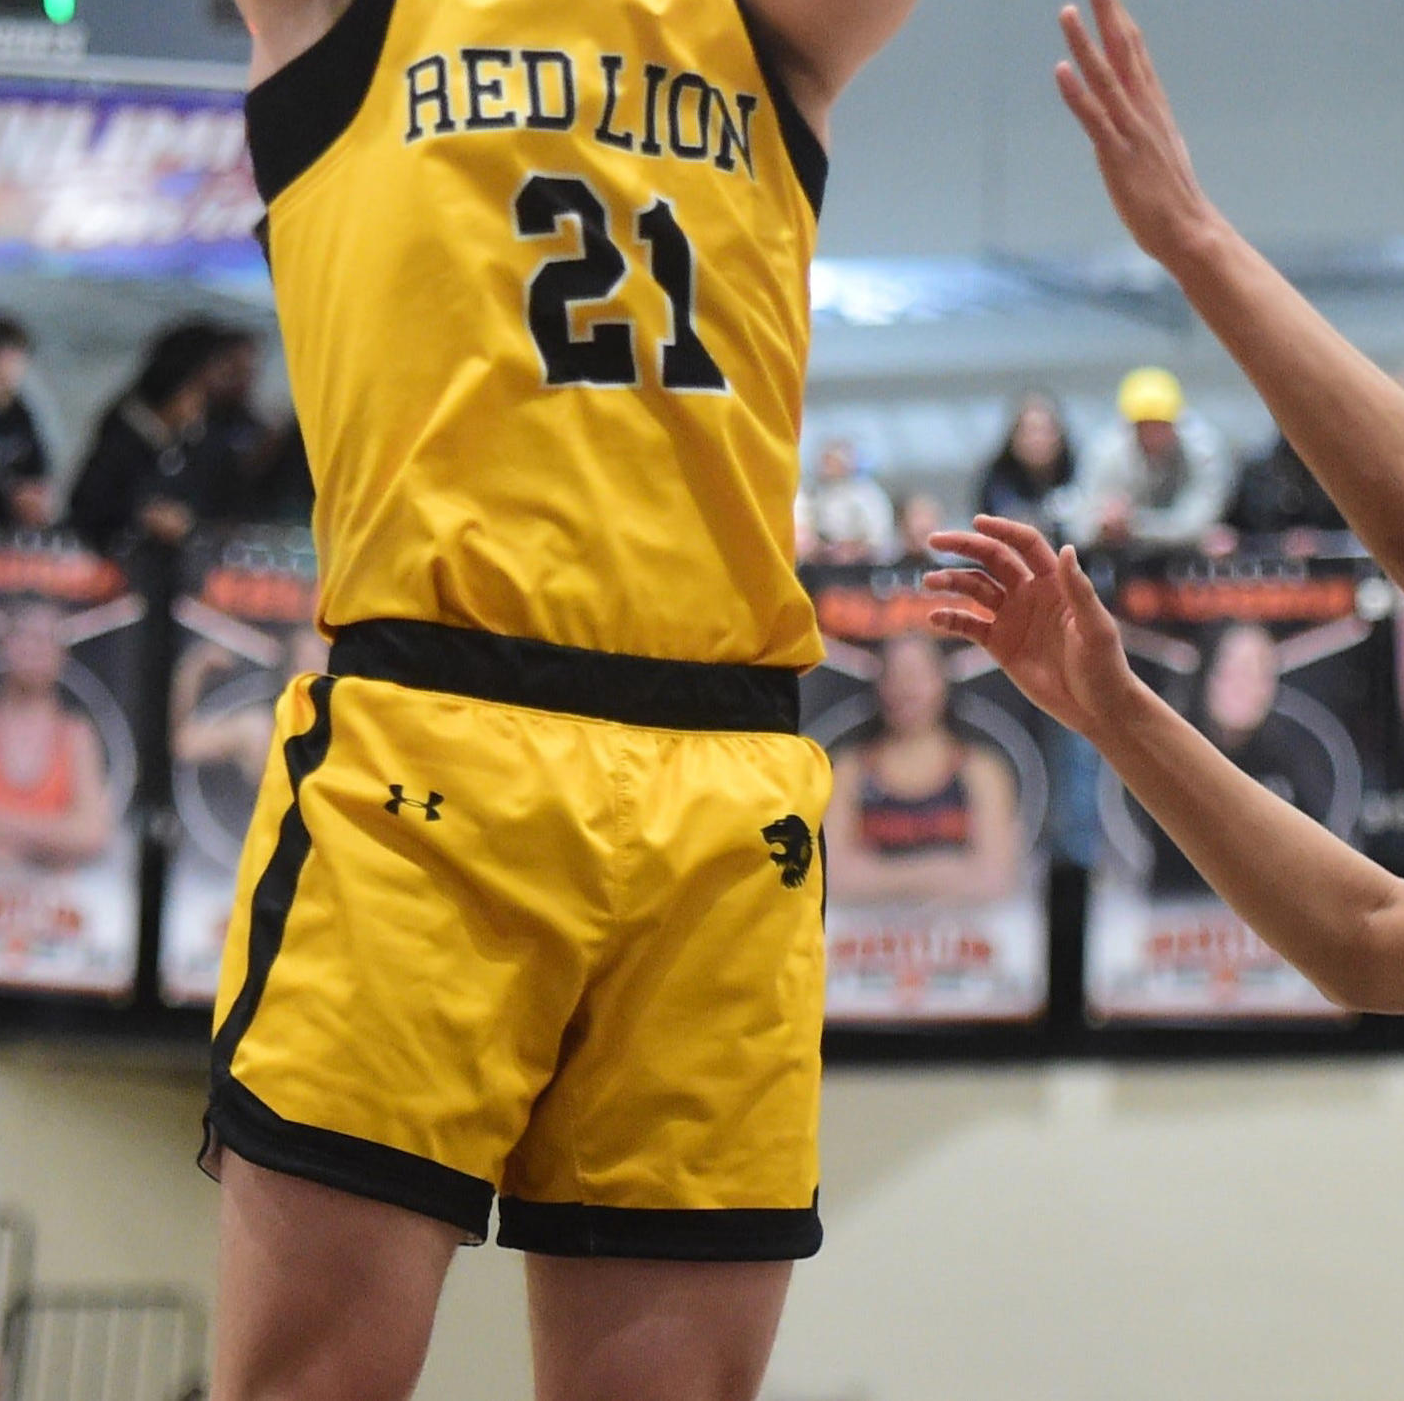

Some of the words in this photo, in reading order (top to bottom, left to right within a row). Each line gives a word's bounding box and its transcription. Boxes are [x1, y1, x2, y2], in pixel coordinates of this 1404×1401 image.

[404, 47, 577, 145] RED
[594, 54, 759, 181] LION
[510, 168, 732, 397] 21
